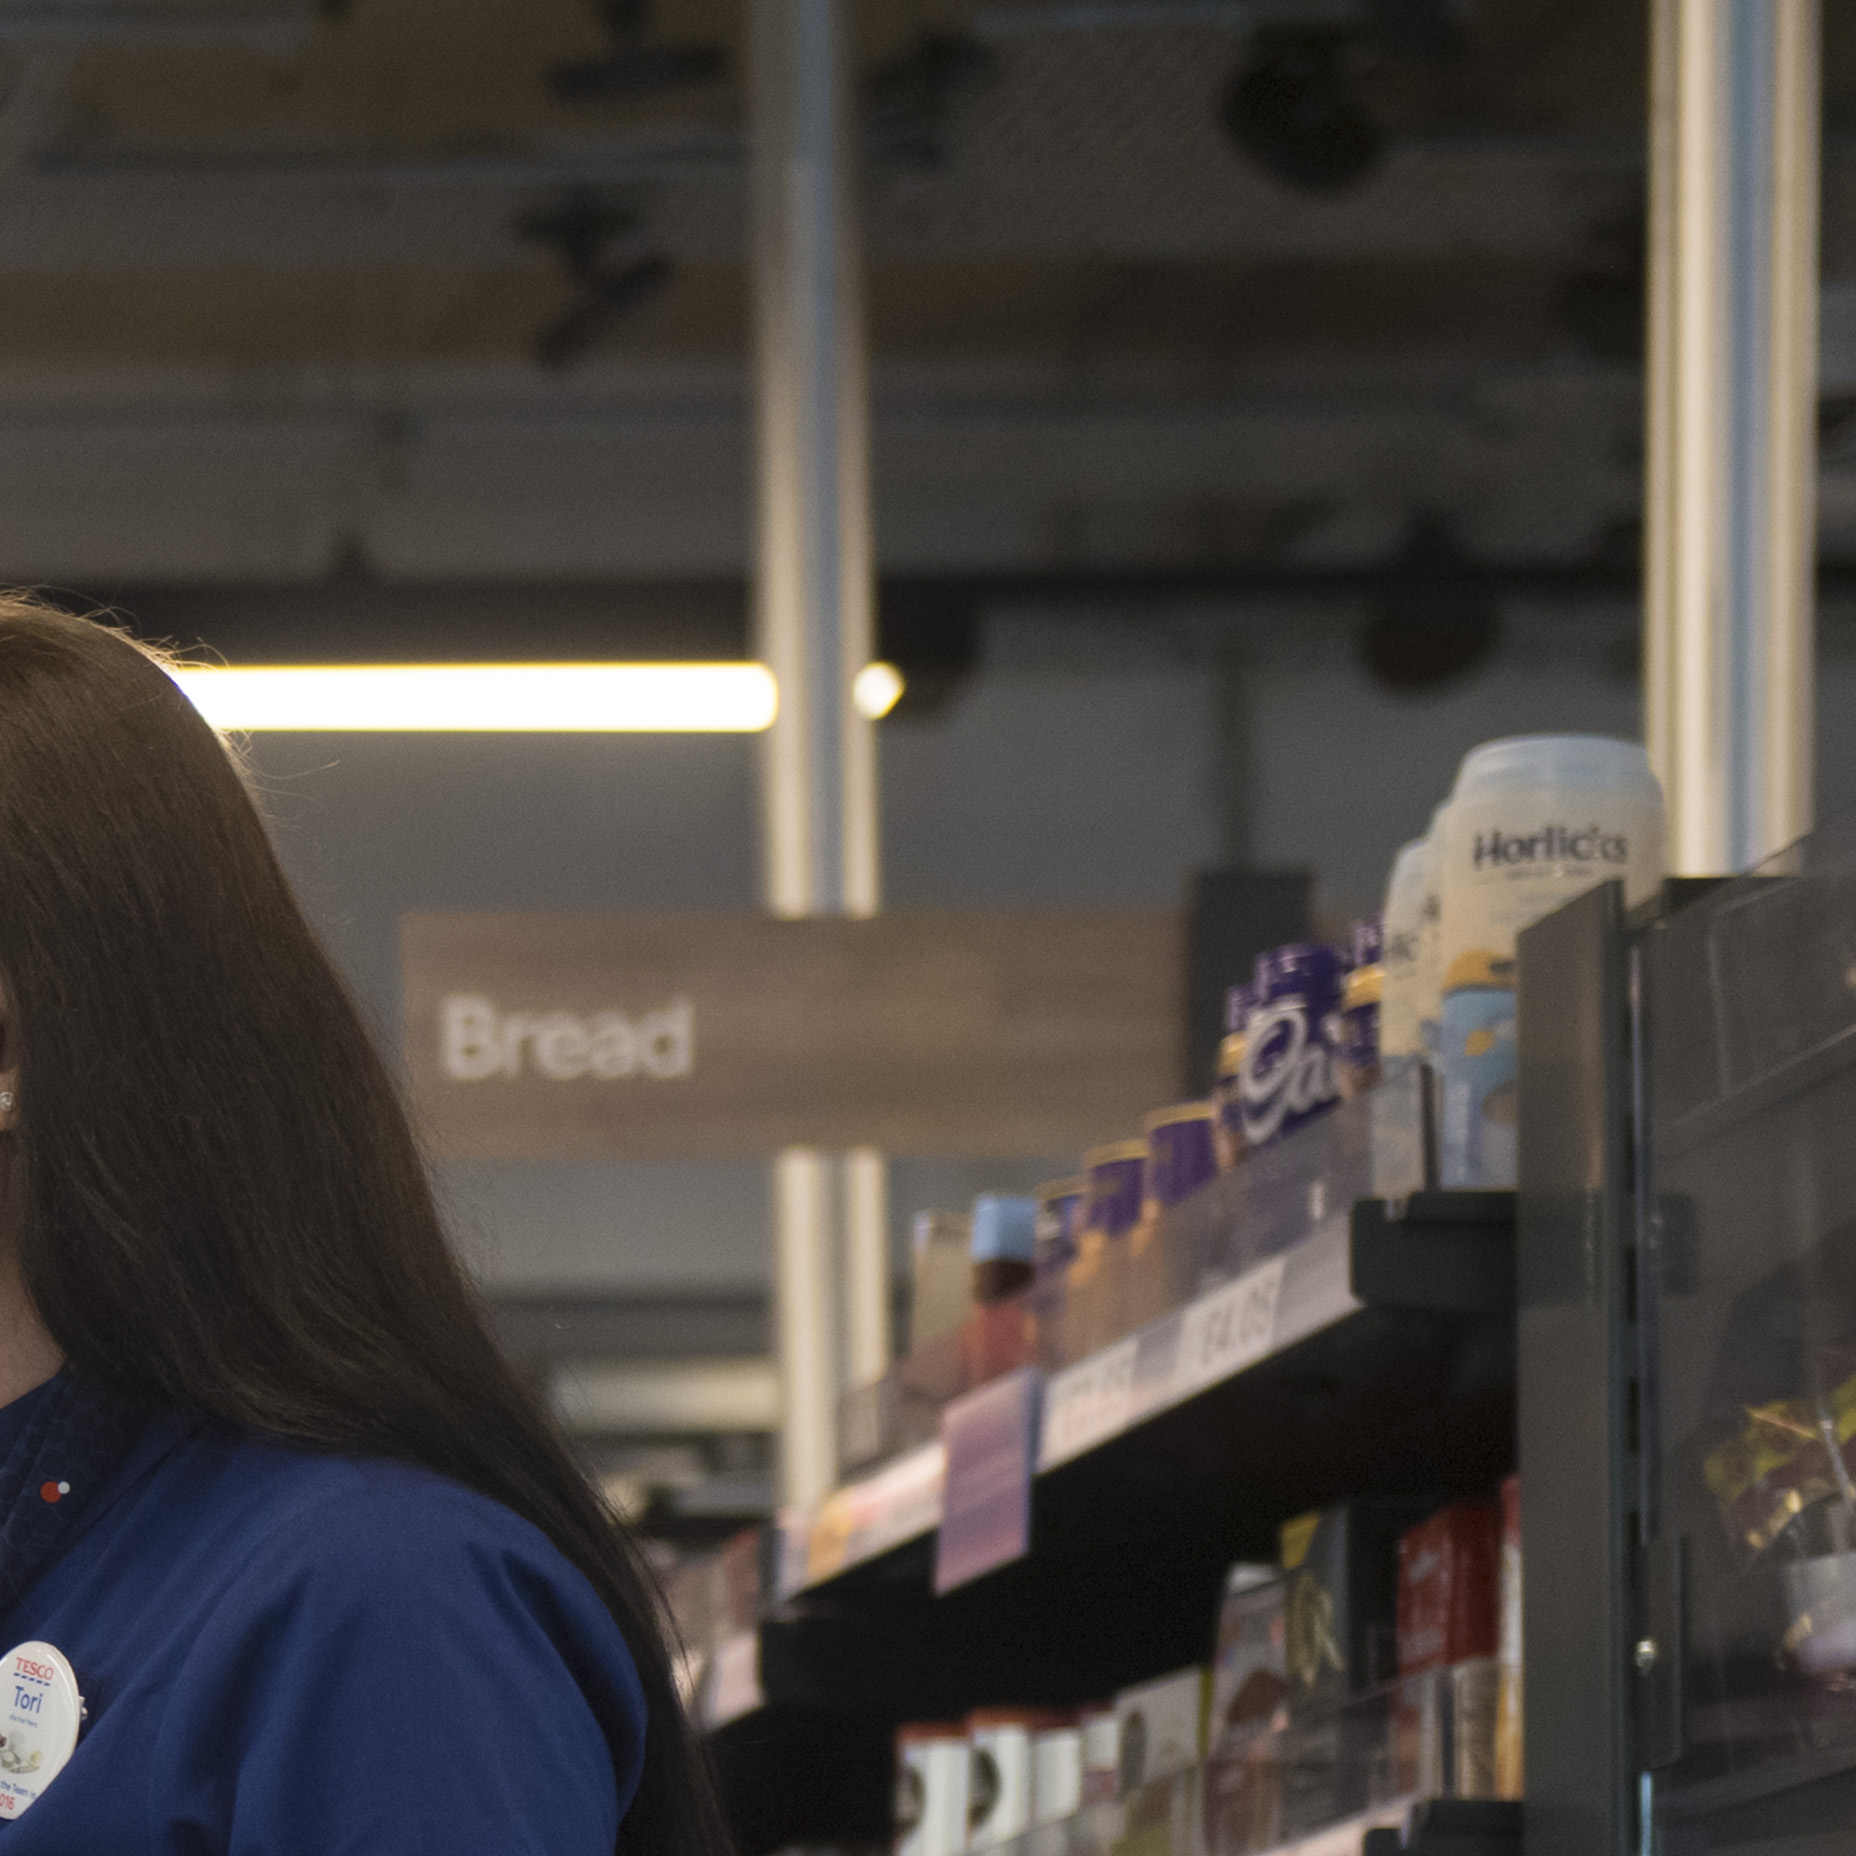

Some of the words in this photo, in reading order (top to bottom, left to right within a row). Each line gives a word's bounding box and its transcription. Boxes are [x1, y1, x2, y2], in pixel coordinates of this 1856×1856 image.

[440, 993, 694, 1080] Bread
[16, 1657, 54, 1681] TESCO
[14, 1685, 43, 1713] Tori
[0, 1779, 12, 1791] the
